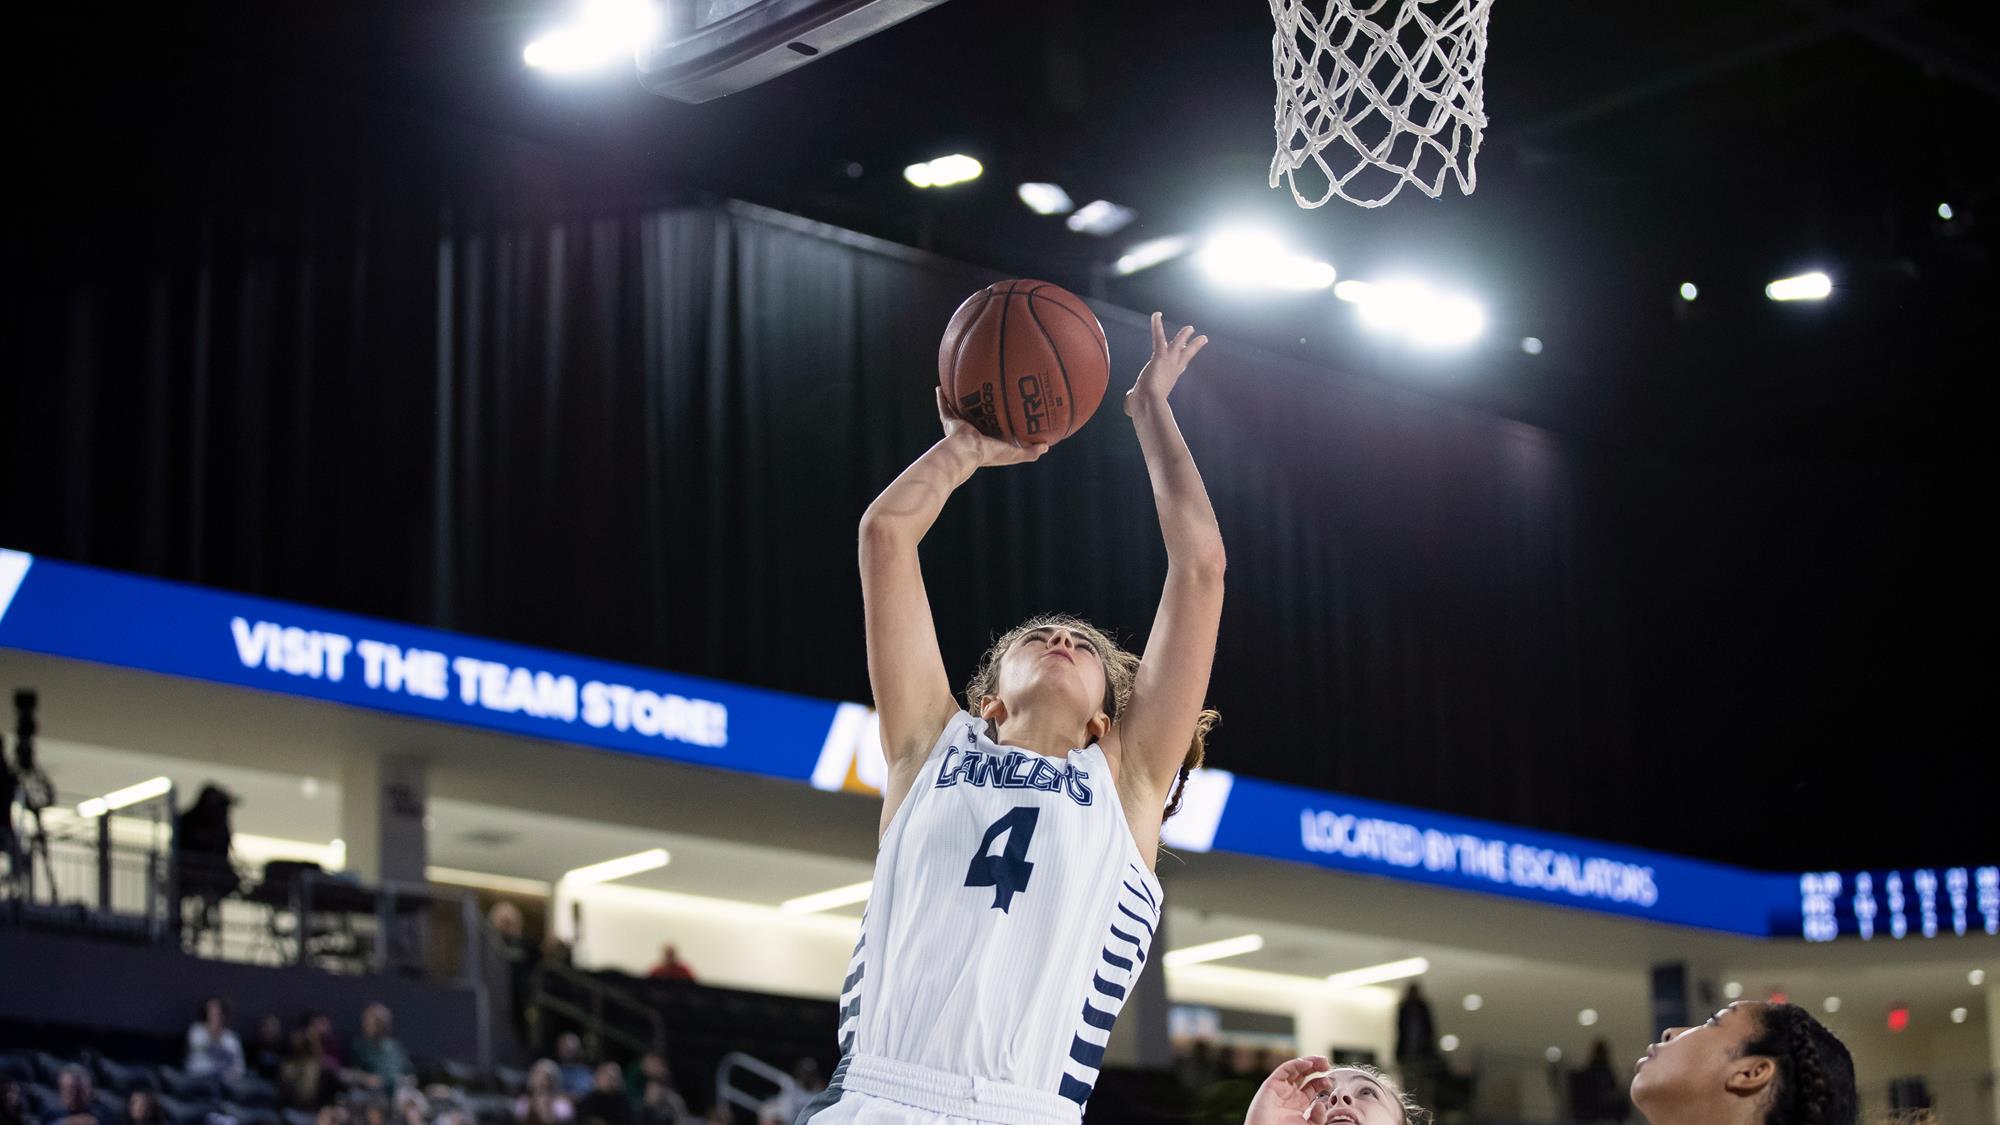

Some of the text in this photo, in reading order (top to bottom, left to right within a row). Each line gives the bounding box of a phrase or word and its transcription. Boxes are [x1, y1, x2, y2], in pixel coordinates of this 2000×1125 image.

[1018, 375, 1043, 435] PRO
[231, 617, 351, 681] VISIT
[357, 640, 448, 699] THE
[453, 657, 577, 722] TEAM
[935, 746, 1093, 806] LANCERS
[964, 807, 1040, 914] 4
[1300, 808, 1658, 907] LOCATED BY THE ESCALATORS
